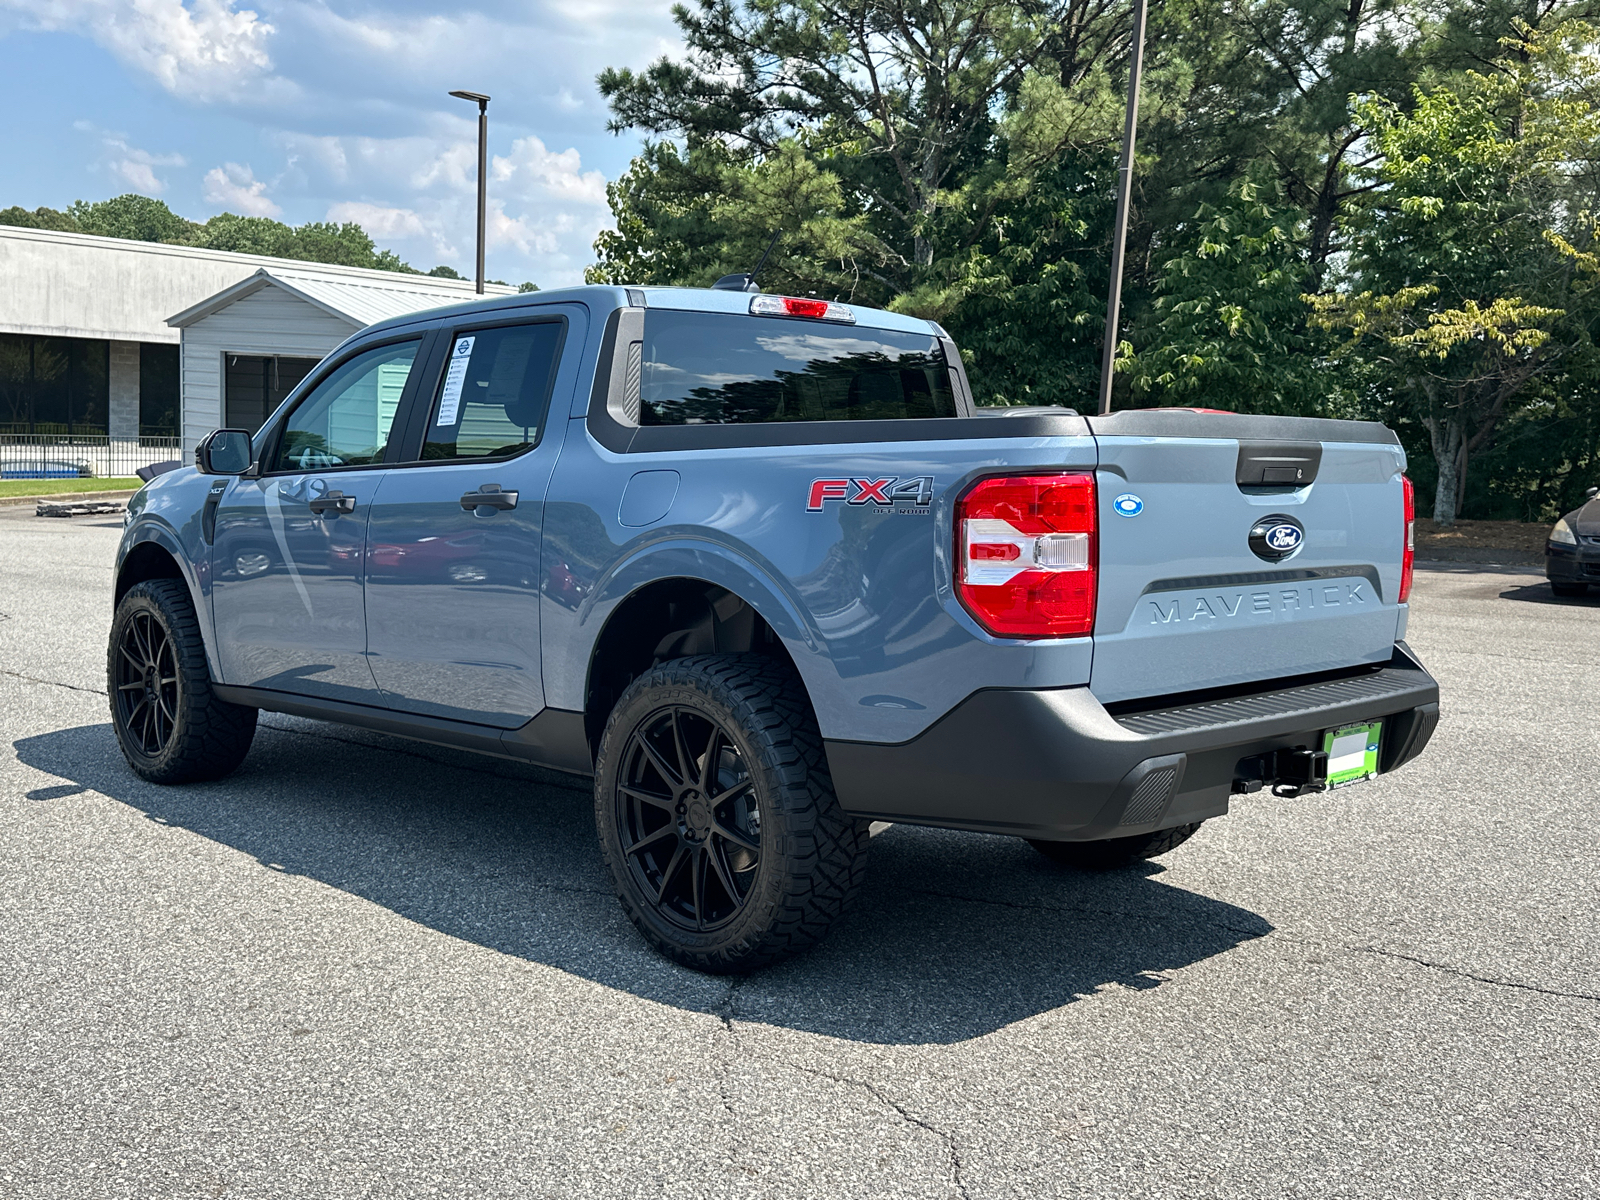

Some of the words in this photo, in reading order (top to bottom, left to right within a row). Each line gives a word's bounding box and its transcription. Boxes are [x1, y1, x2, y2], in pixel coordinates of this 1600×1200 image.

[805, 476, 934, 513] FX4
[1273, 528, 1297, 546] Ford
[1149, 583, 1365, 625] MAVERICK
